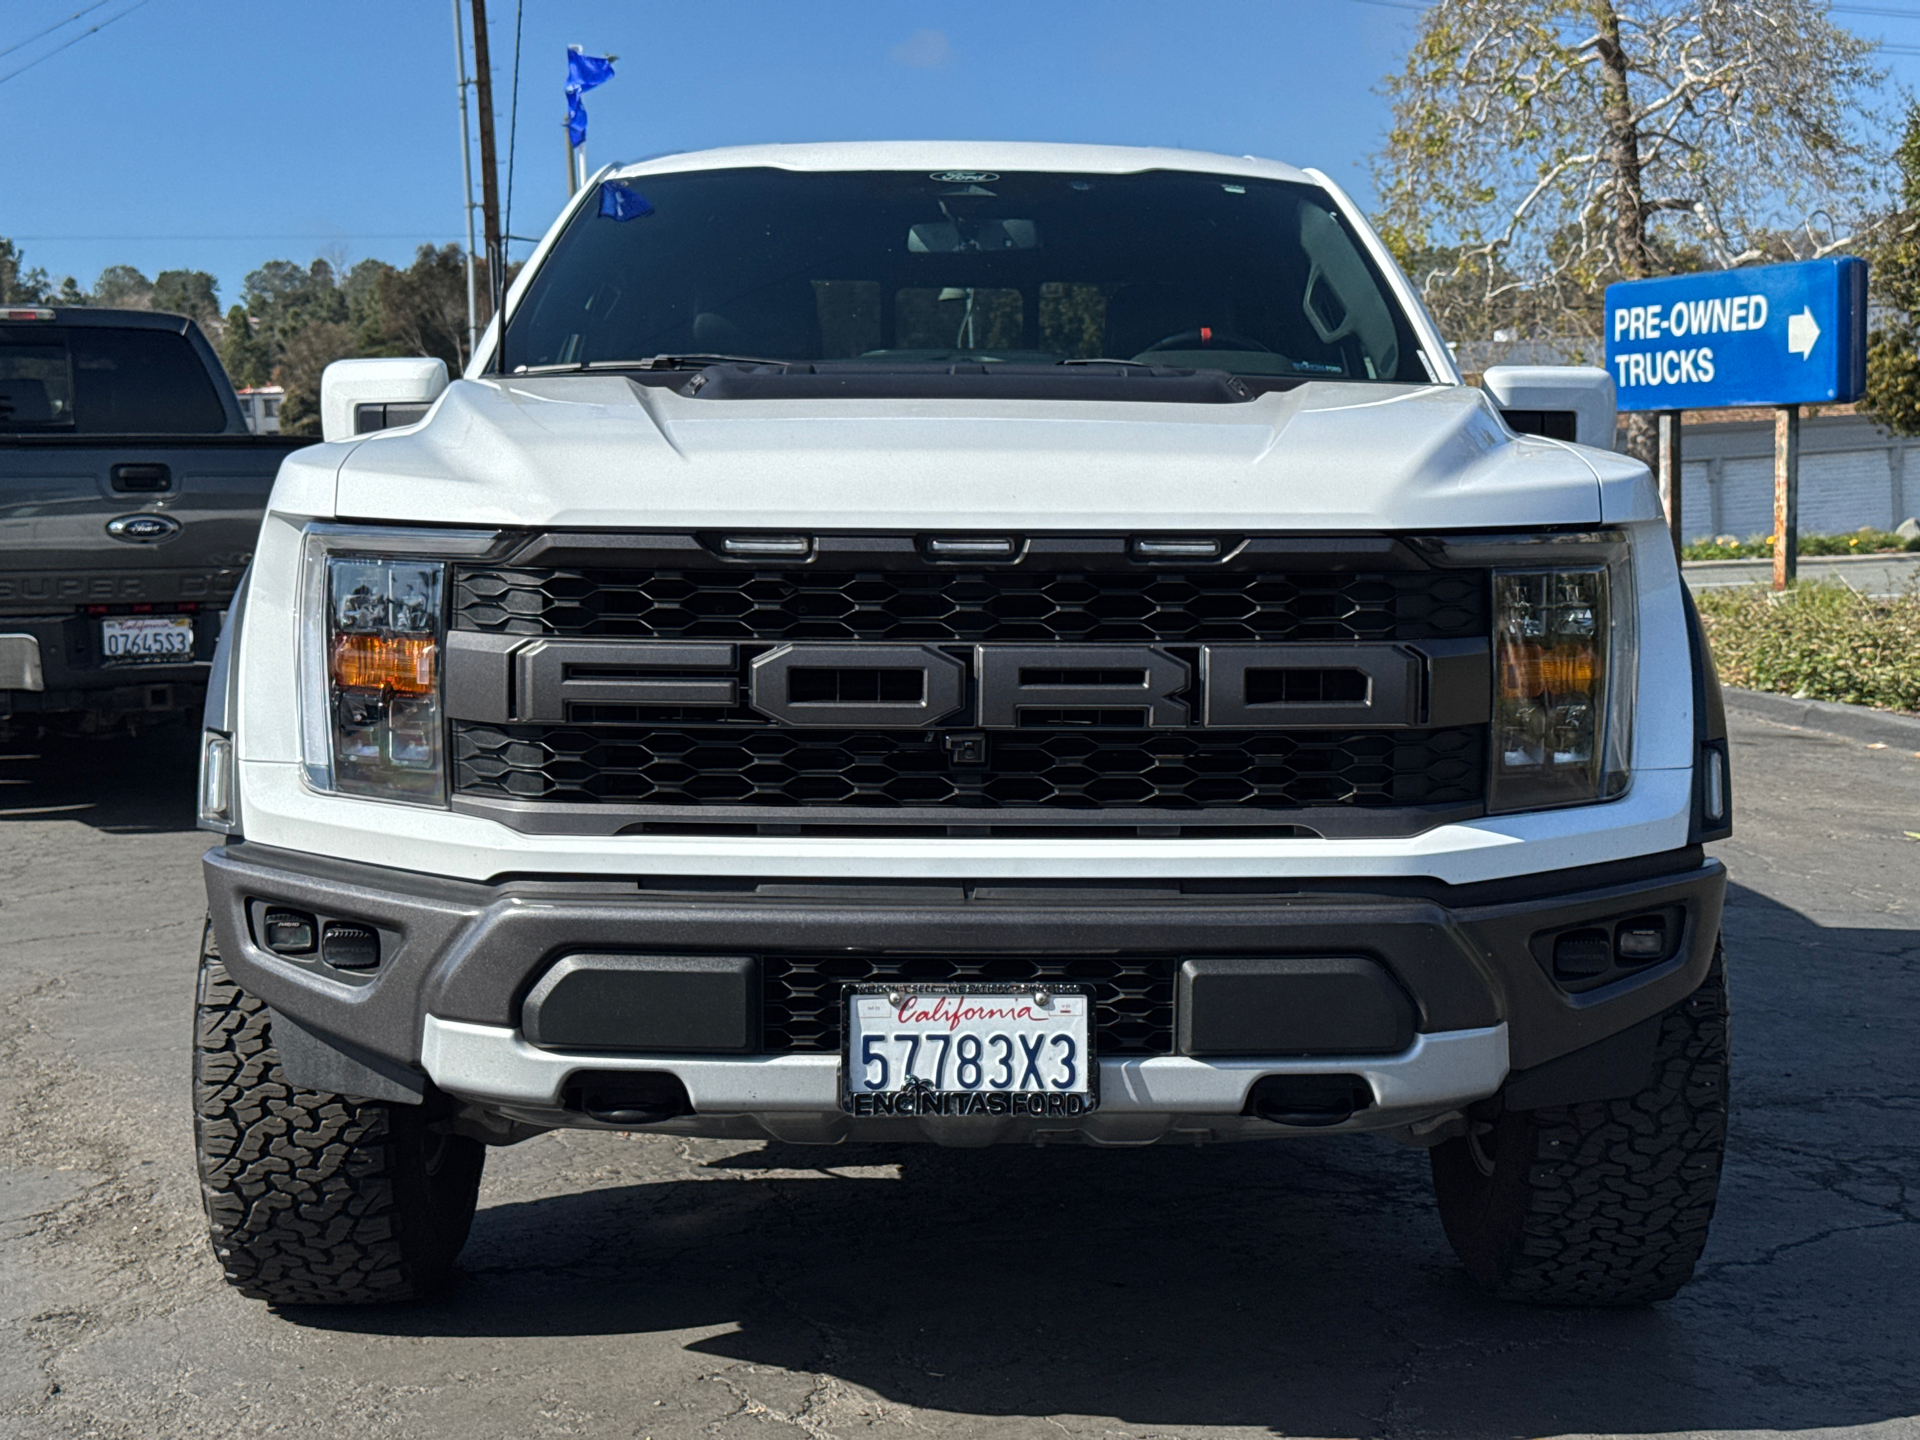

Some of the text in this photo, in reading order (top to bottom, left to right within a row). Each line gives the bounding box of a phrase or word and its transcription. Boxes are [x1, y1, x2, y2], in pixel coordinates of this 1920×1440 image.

[1614, 294, 1768, 342] PRE-OWNED
[1615, 347, 1715, 387] TRUCKS
[181, 576, 236, 597] DU
[514, 640, 1424, 728] FORD
[898, 996, 1048, 1031] California
[862, 1033, 1076, 1090] 57783X3
[853, 1091, 1084, 1117] ENCINITAS FORD
